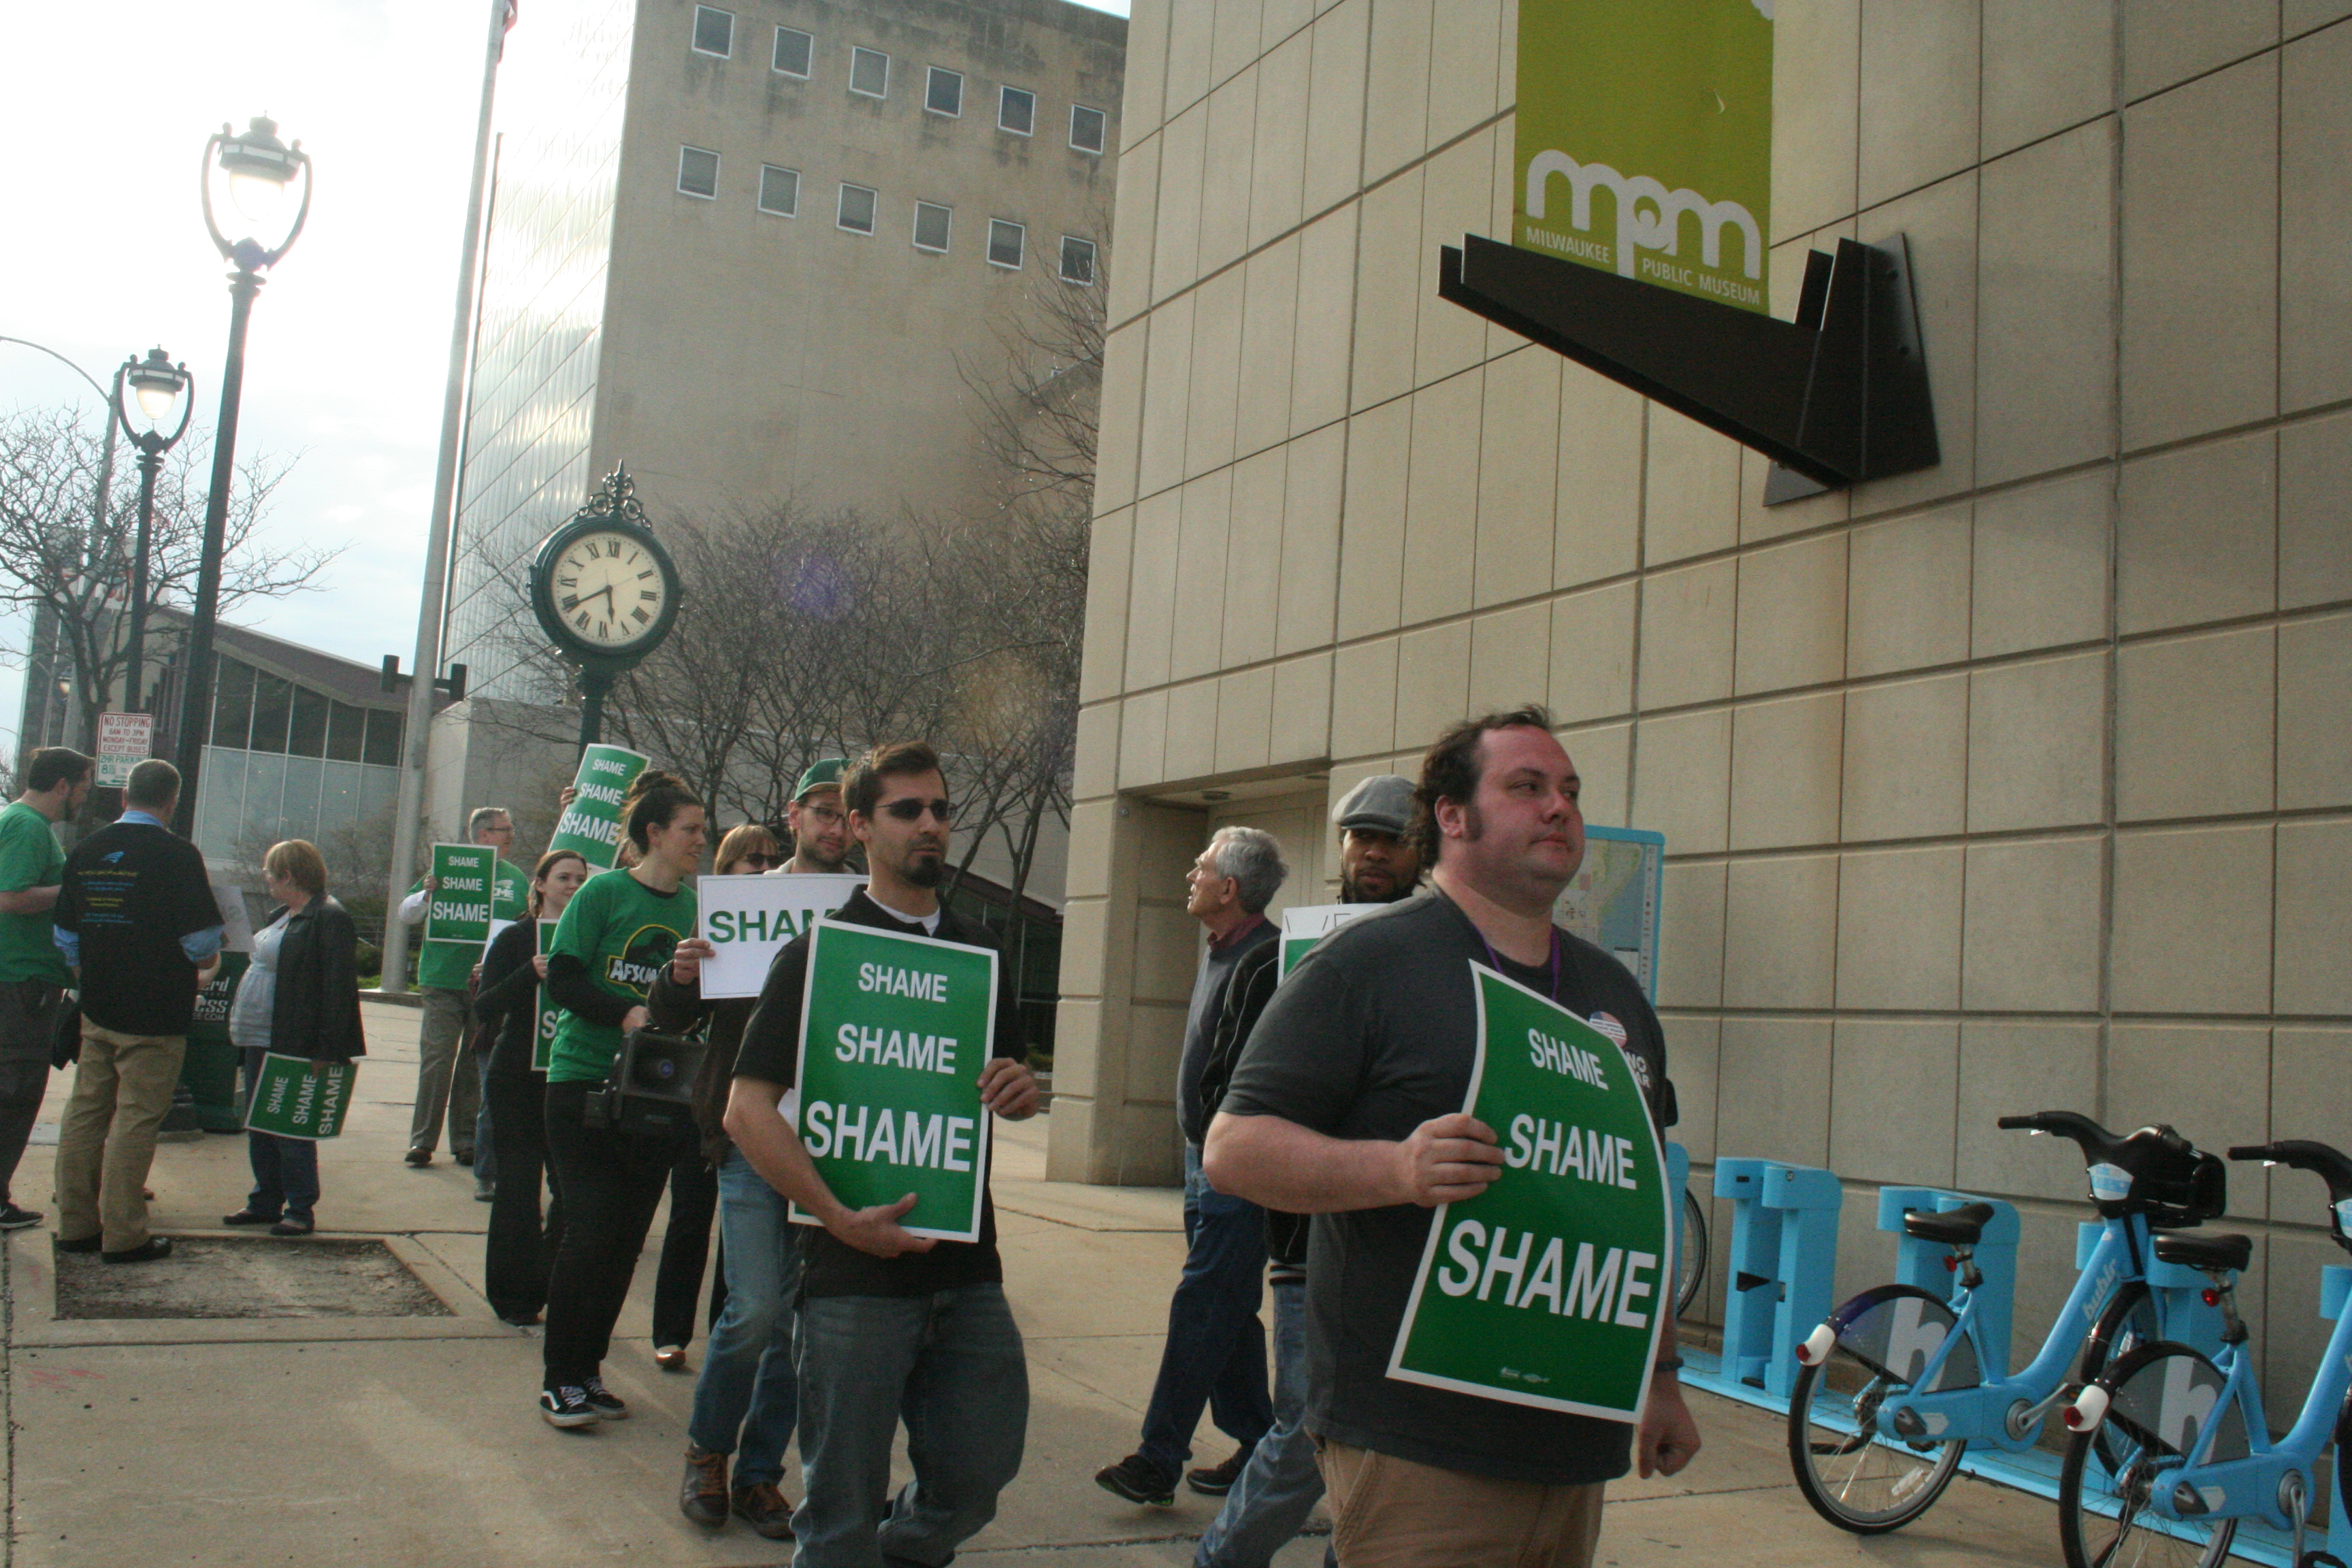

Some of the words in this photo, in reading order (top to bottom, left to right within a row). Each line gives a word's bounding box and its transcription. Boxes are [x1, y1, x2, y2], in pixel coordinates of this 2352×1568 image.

[1526, 149, 1761, 280] mpm
[1526, 226, 1610, 264] MILWAUKEE
[1642, 258, 1693, 287] PUBLIC
[1699, 274, 1760, 306] MUSEUM
[103, 717, 114, 726] NO
[116, 717, 150, 728] STOPPING
[116, 755, 149, 764] PARKIN
[592, 759, 627, 776] SHAME
[579, 783, 624, 806] SHAME
[559, 812, 622, 846] SHAME
[448, 855, 480, 868] SHAME
[442, 876, 483, 892] SHAME
[432, 901, 489, 922] SHAME
[858, 962, 948, 1003] SHAME
[835, 1023, 958, 1075] SHAME
[1528, 1027, 1609, 1092] SHAME
[267, 1077, 289, 1114] SHAME
[292, 1074, 317, 1125] SHAME
[318, 1066, 344, 1135] SHAME
[804, 1100, 974, 1173] SHAME
[1504, 1113, 1637, 1191] SHAME
[1437, 1219, 1656, 1329] SHAME
